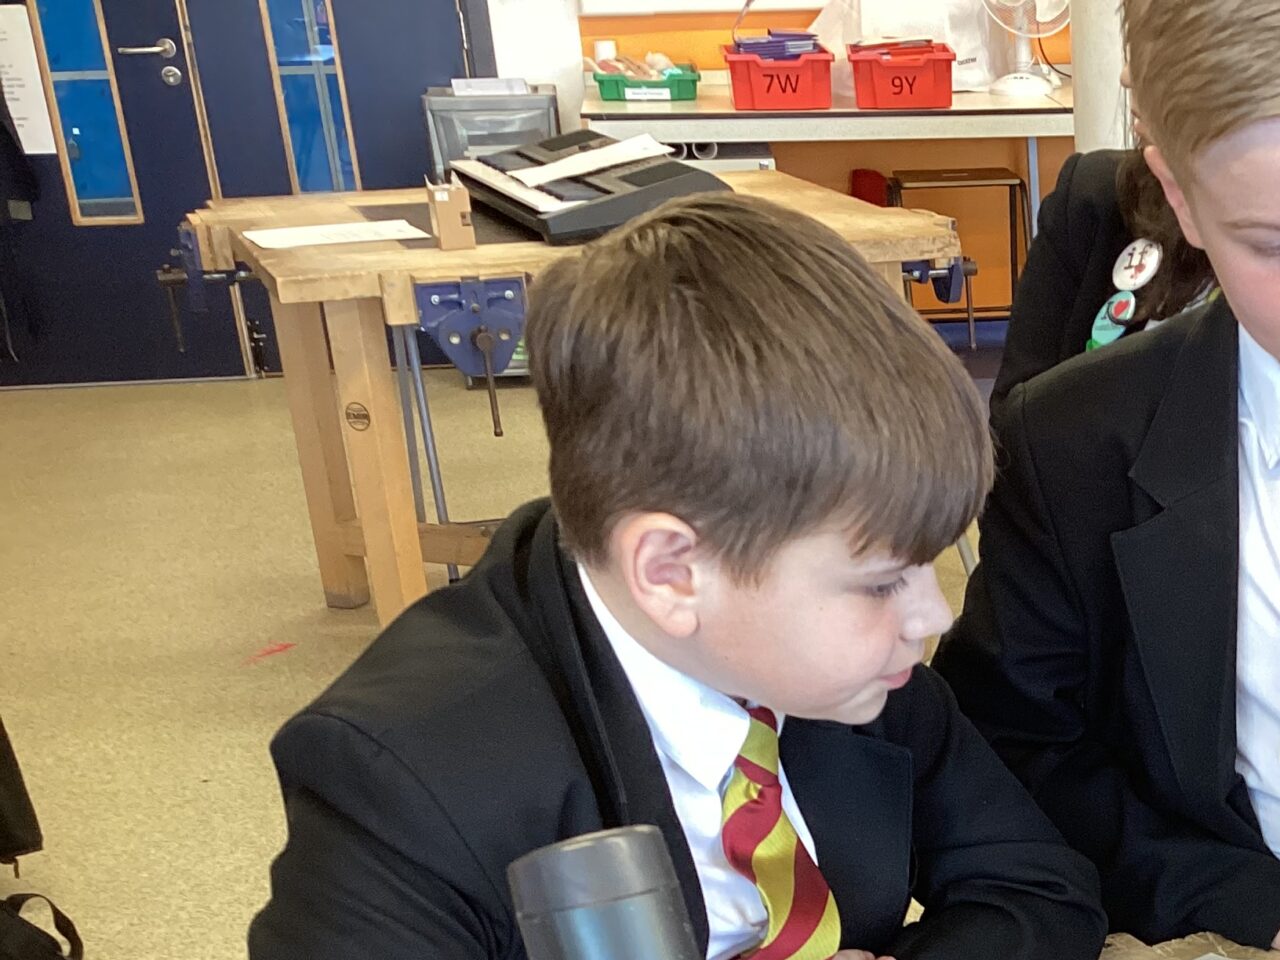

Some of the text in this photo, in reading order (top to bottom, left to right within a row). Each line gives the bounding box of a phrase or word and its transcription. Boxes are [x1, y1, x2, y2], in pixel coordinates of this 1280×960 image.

[762, 74, 800, 94] 7W
[891, 75, 916, 95] 9Y
[1124, 243, 1153, 270] if
